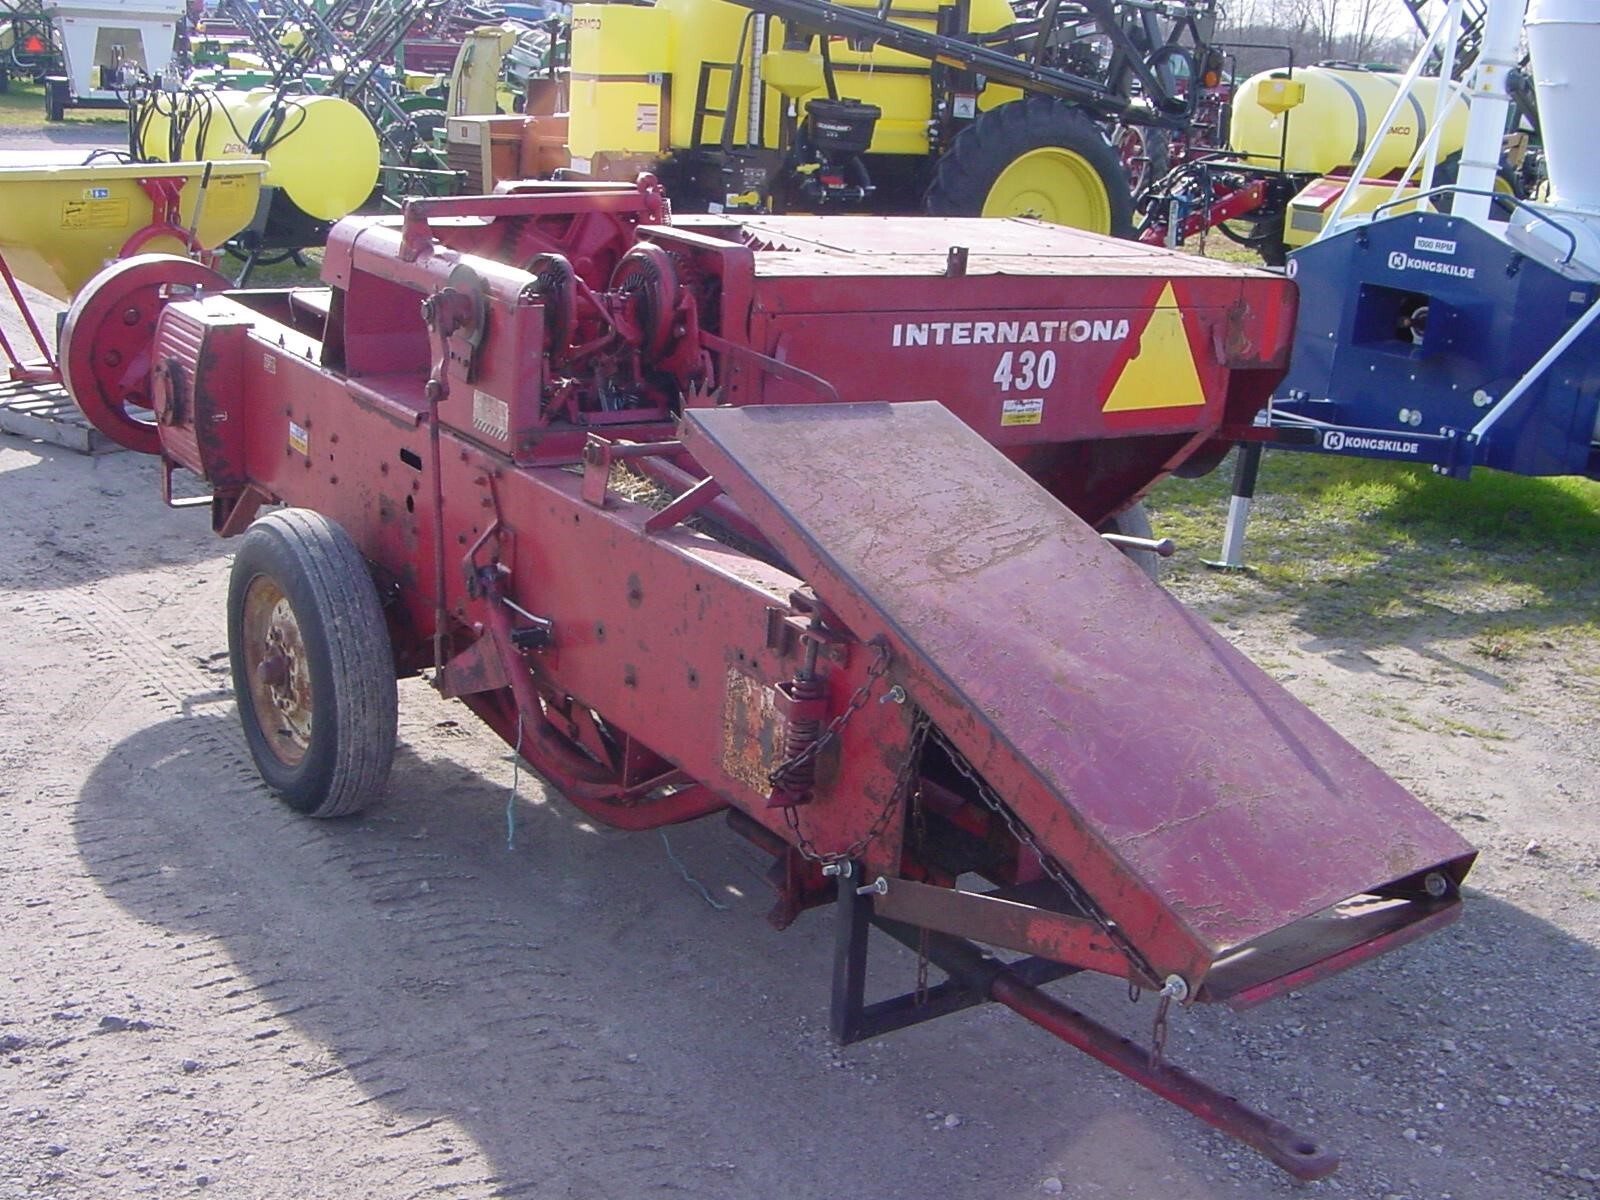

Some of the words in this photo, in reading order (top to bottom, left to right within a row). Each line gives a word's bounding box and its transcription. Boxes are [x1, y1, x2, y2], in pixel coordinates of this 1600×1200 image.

[1435, 242, 1453, 251] RPM
[1407, 257, 1475, 279] KONGSKILDE
[993, 350, 1056, 392] 430
[1344, 436, 1418, 454] KONGSKILDE
